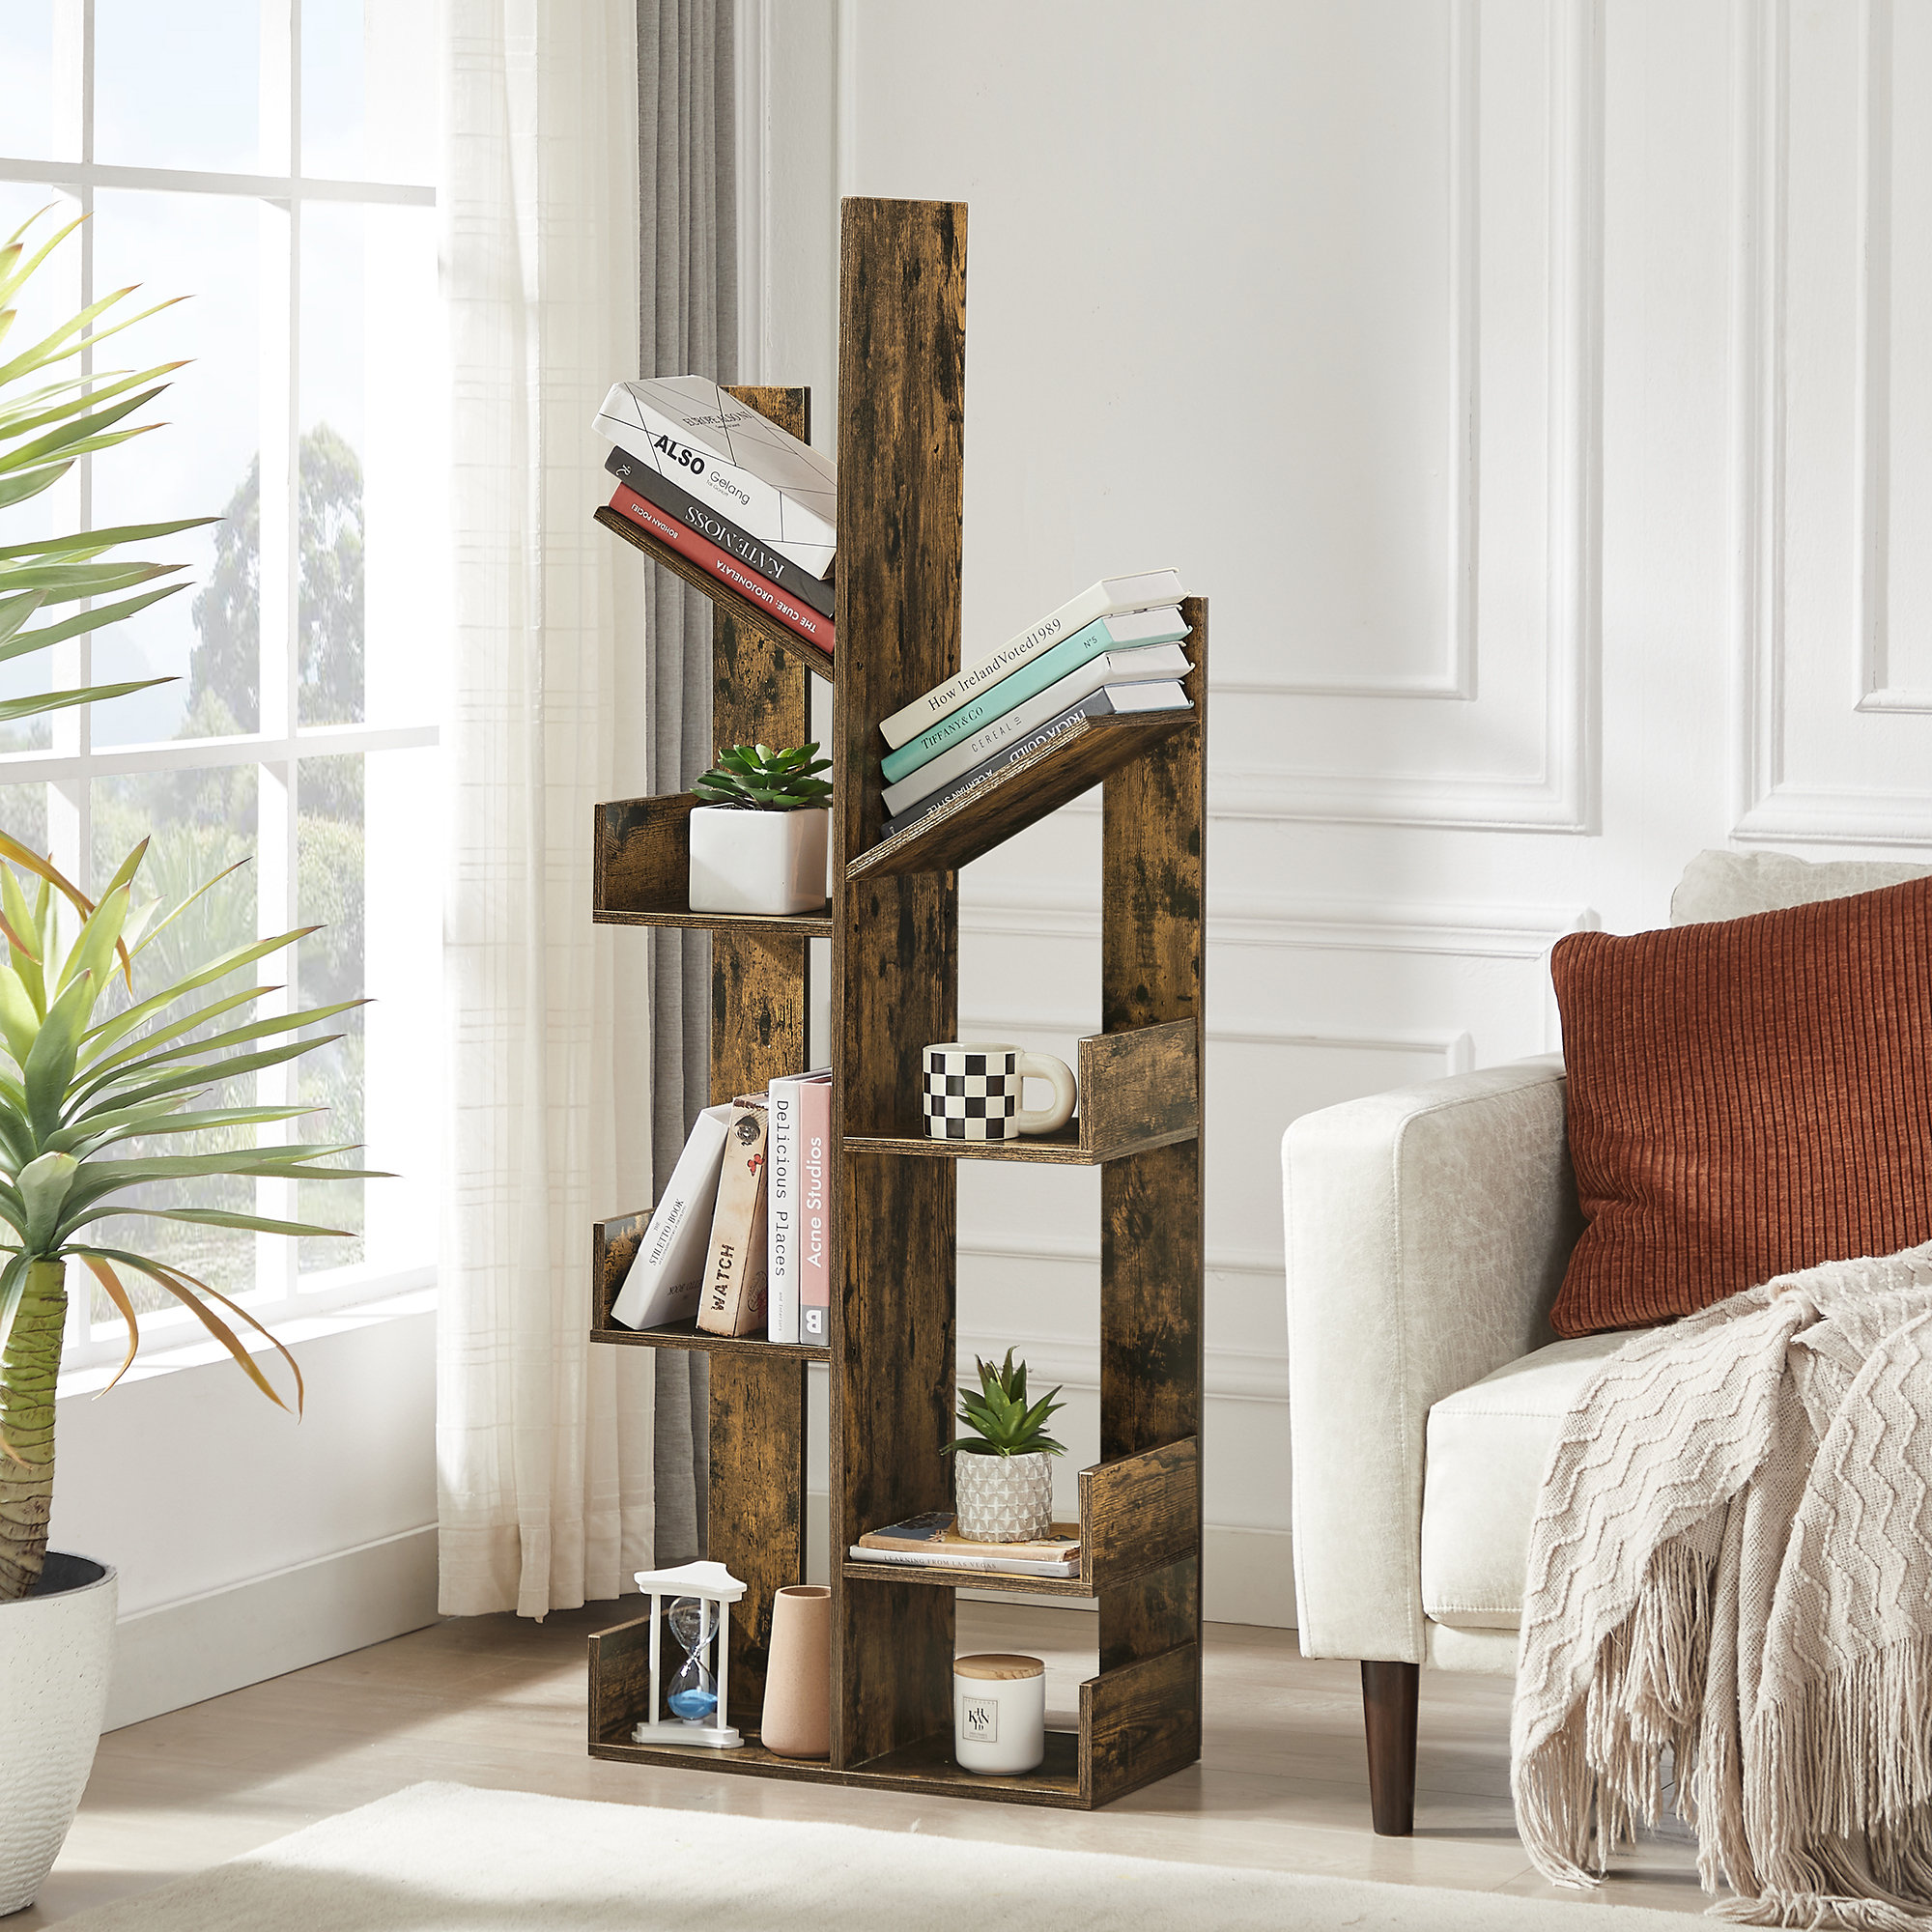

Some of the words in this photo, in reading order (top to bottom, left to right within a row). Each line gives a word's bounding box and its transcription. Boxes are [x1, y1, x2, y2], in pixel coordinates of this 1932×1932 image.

[654, 435, 705, 475] ALSO
[710, 470, 751, 505] Gelang
[631, 503, 652, 522] POCIEJ
[652, 517, 679, 539] BOHDAN
[685, 506, 737, 548] MOSS
[735, 538, 785, 580] KATE
[716, 559, 774, 604] UROJONELATA
[775, 599, 800, 621] CURE:
[800, 616, 817, 634] THE
[928, 687, 956, 712] How
[971, 724, 1011, 753] CEREAL
[1046, 709, 1087, 739] TRICIA
[1009, 735, 1047, 763] GUILD
[776, 1100, 790, 1199] Delicious
[806, 1137, 822, 1210] Studios
[649, 1225, 671, 1266] STILETTO
[668, 1198, 684, 1224] BOOK
[775, 1211, 789, 1276] Places
[806, 1216, 822, 1268] Acne
[710, 1243, 735, 1311] WATCH
[884, 1555, 924, 1564] LEARNING
